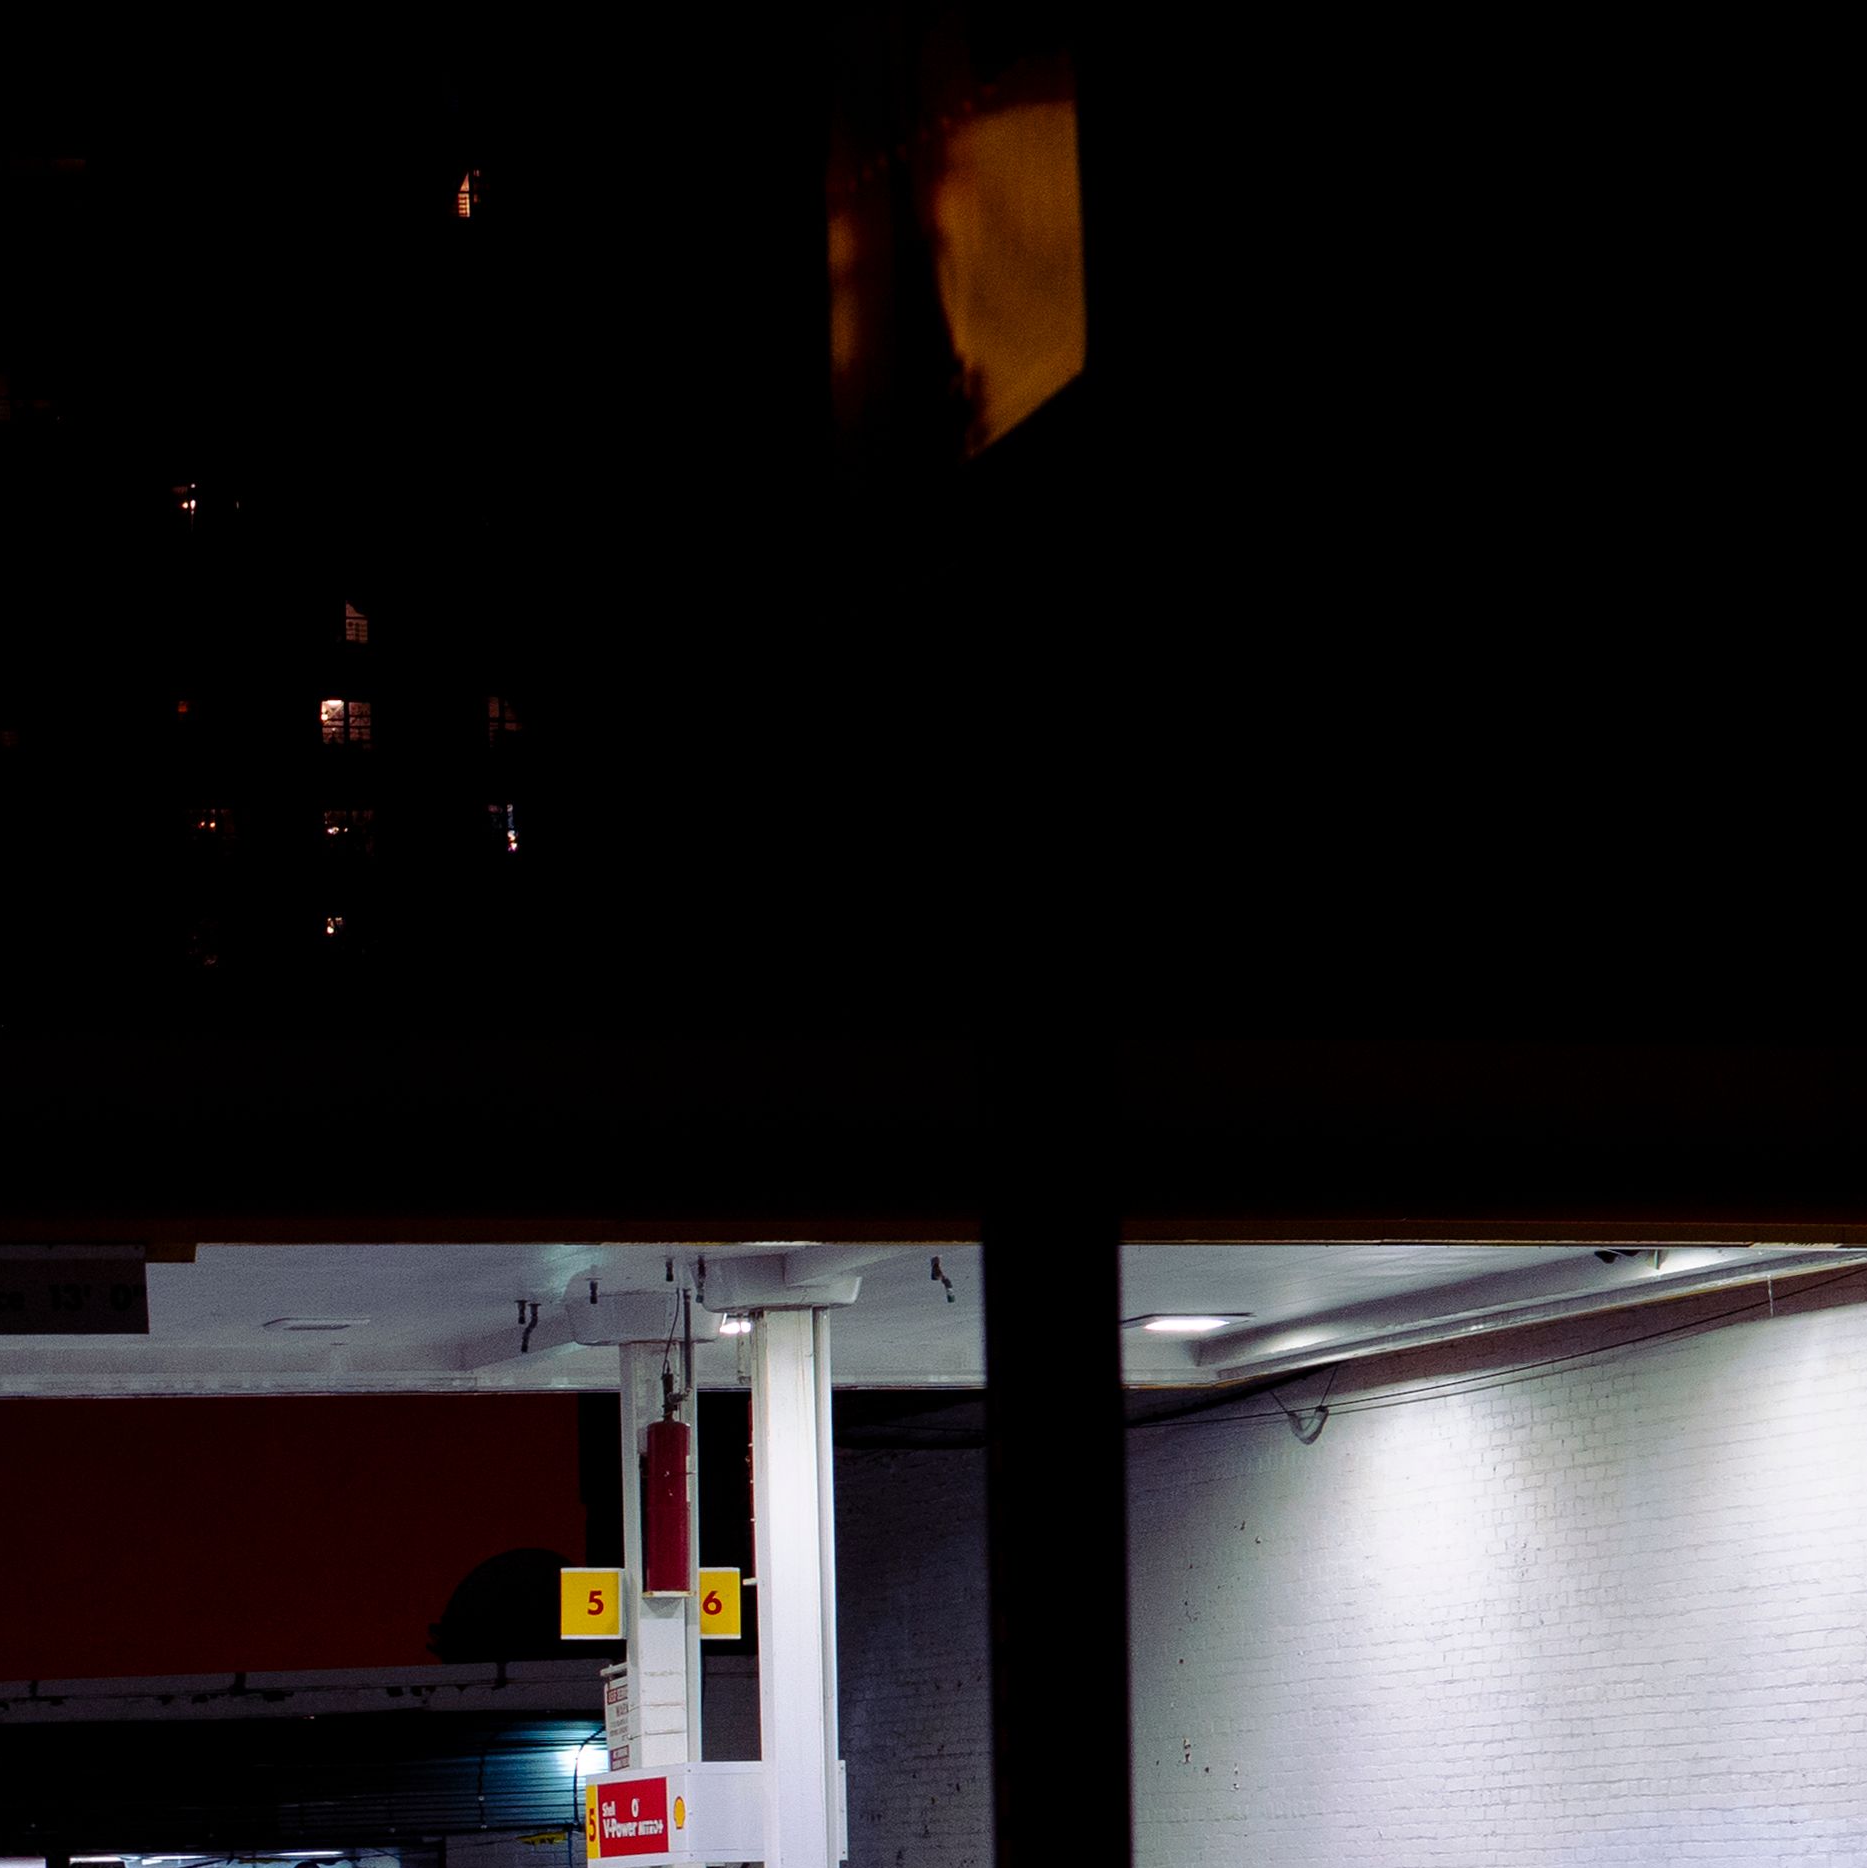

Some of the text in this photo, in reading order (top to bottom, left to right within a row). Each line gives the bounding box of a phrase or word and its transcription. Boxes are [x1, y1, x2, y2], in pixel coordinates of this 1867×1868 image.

[587, 1590, 604, 1615] 5
[702, 1590, 723, 1616] 6
[589, 1808, 597, 1842] 5
[602, 1817, 638, 1839] V-Power
